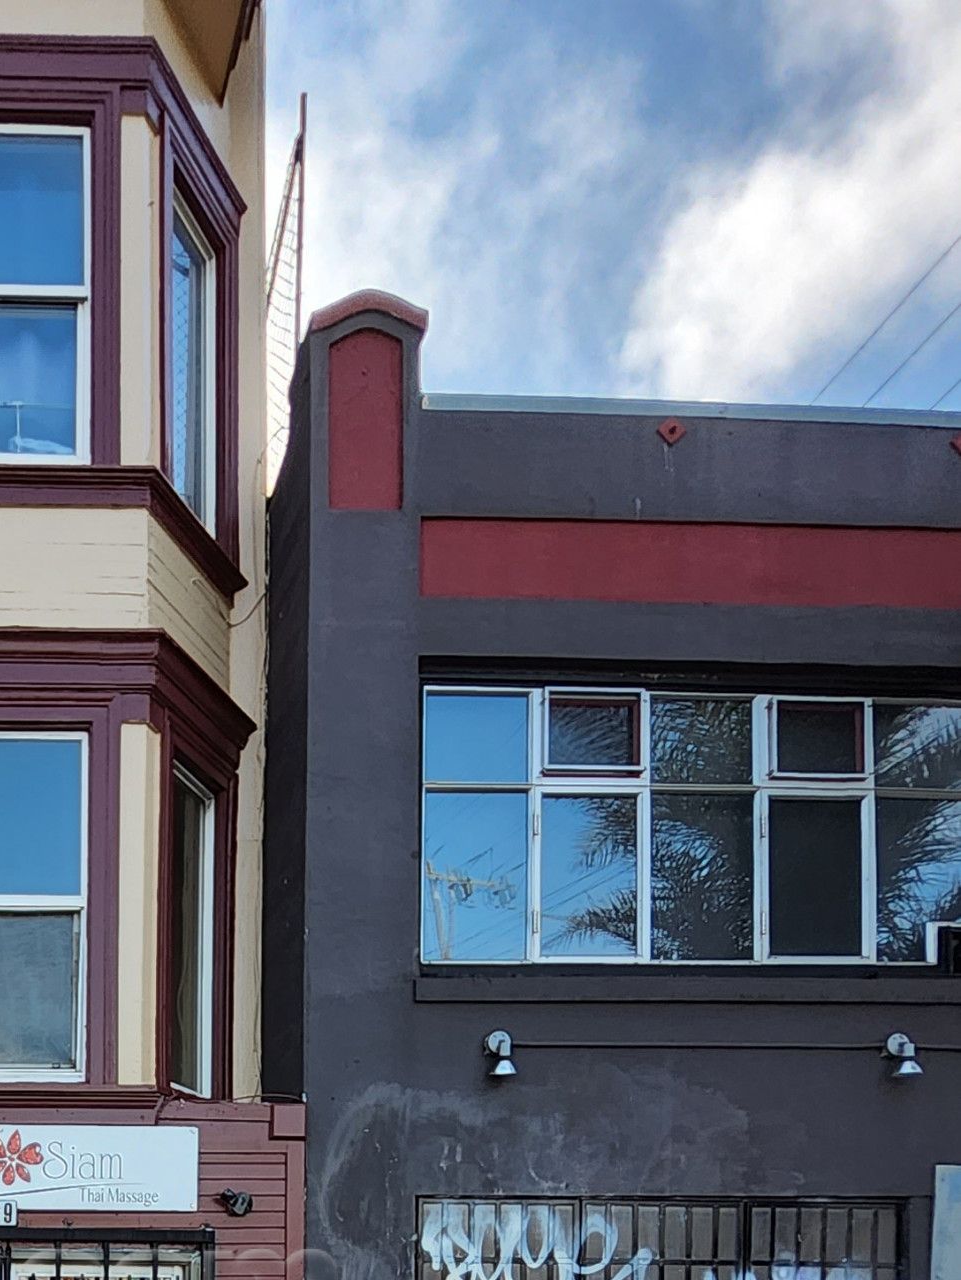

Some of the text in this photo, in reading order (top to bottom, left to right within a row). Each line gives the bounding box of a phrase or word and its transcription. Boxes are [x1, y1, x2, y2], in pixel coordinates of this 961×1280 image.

[42, 1140, 125, 1180] Siam
[80, 1187, 159, 1207] Thai Massage
